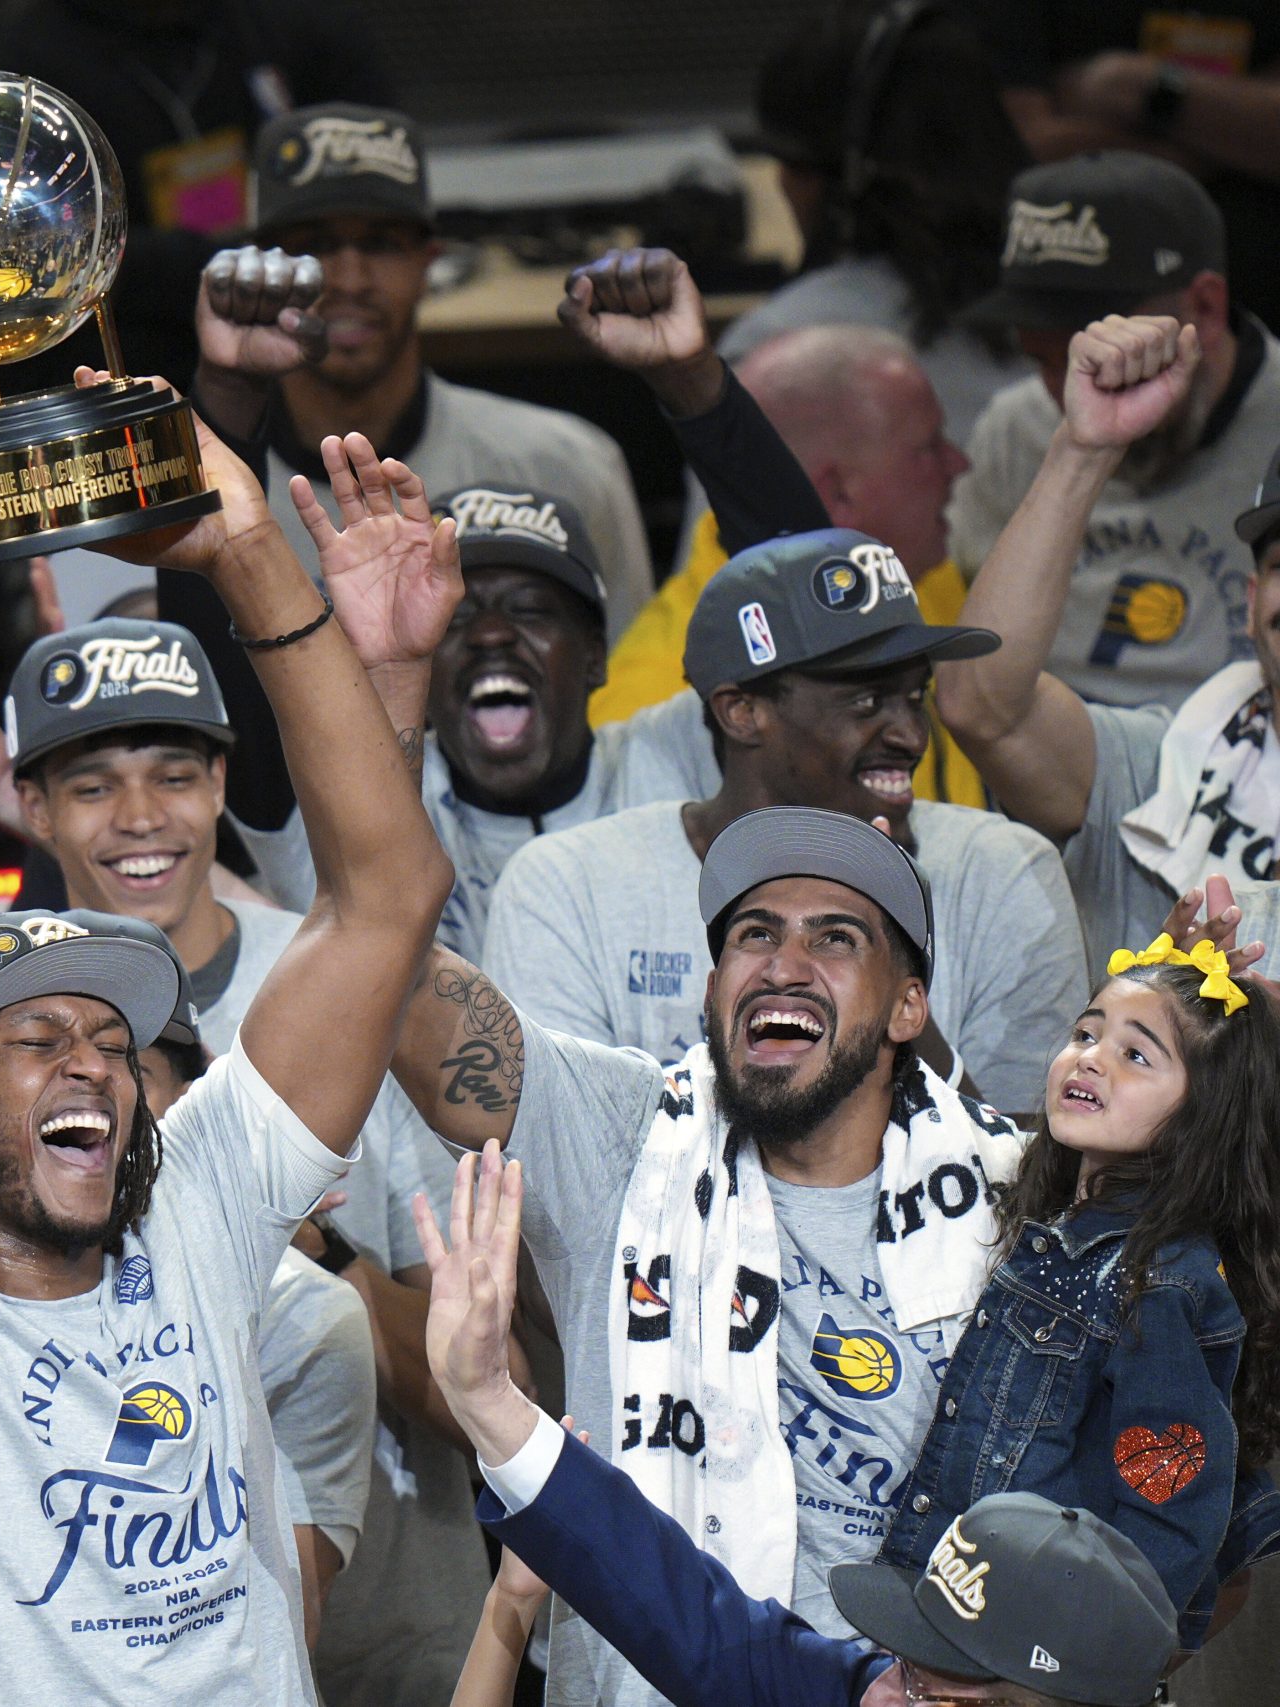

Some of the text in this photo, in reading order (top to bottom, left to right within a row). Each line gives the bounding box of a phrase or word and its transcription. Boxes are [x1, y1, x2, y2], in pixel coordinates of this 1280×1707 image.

[19, 464, 52, 491] BOB
[53, 451, 104, 484] COUSY
[106, 439, 155, 471] TROPHY
[43, 470, 132, 510] CONFERENCE
[132, 455, 189, 489] CHAMPIONS
[451, 489, 569, 551] Finals
[68, 635, 200, 710] Finals
[100, 681, 129, 699] 2025
[843, 1522, 885, 1537] CHA
[124, 1577, 171, 1596] 2024
[182, 1557, 229, 1582] 2025
[165, 1587, 201, 1607] NBA
[71, 1585, 247, 1633] EASTERN CONFEREN
[126, 1611, 225, 1648] CHAMPIONS
